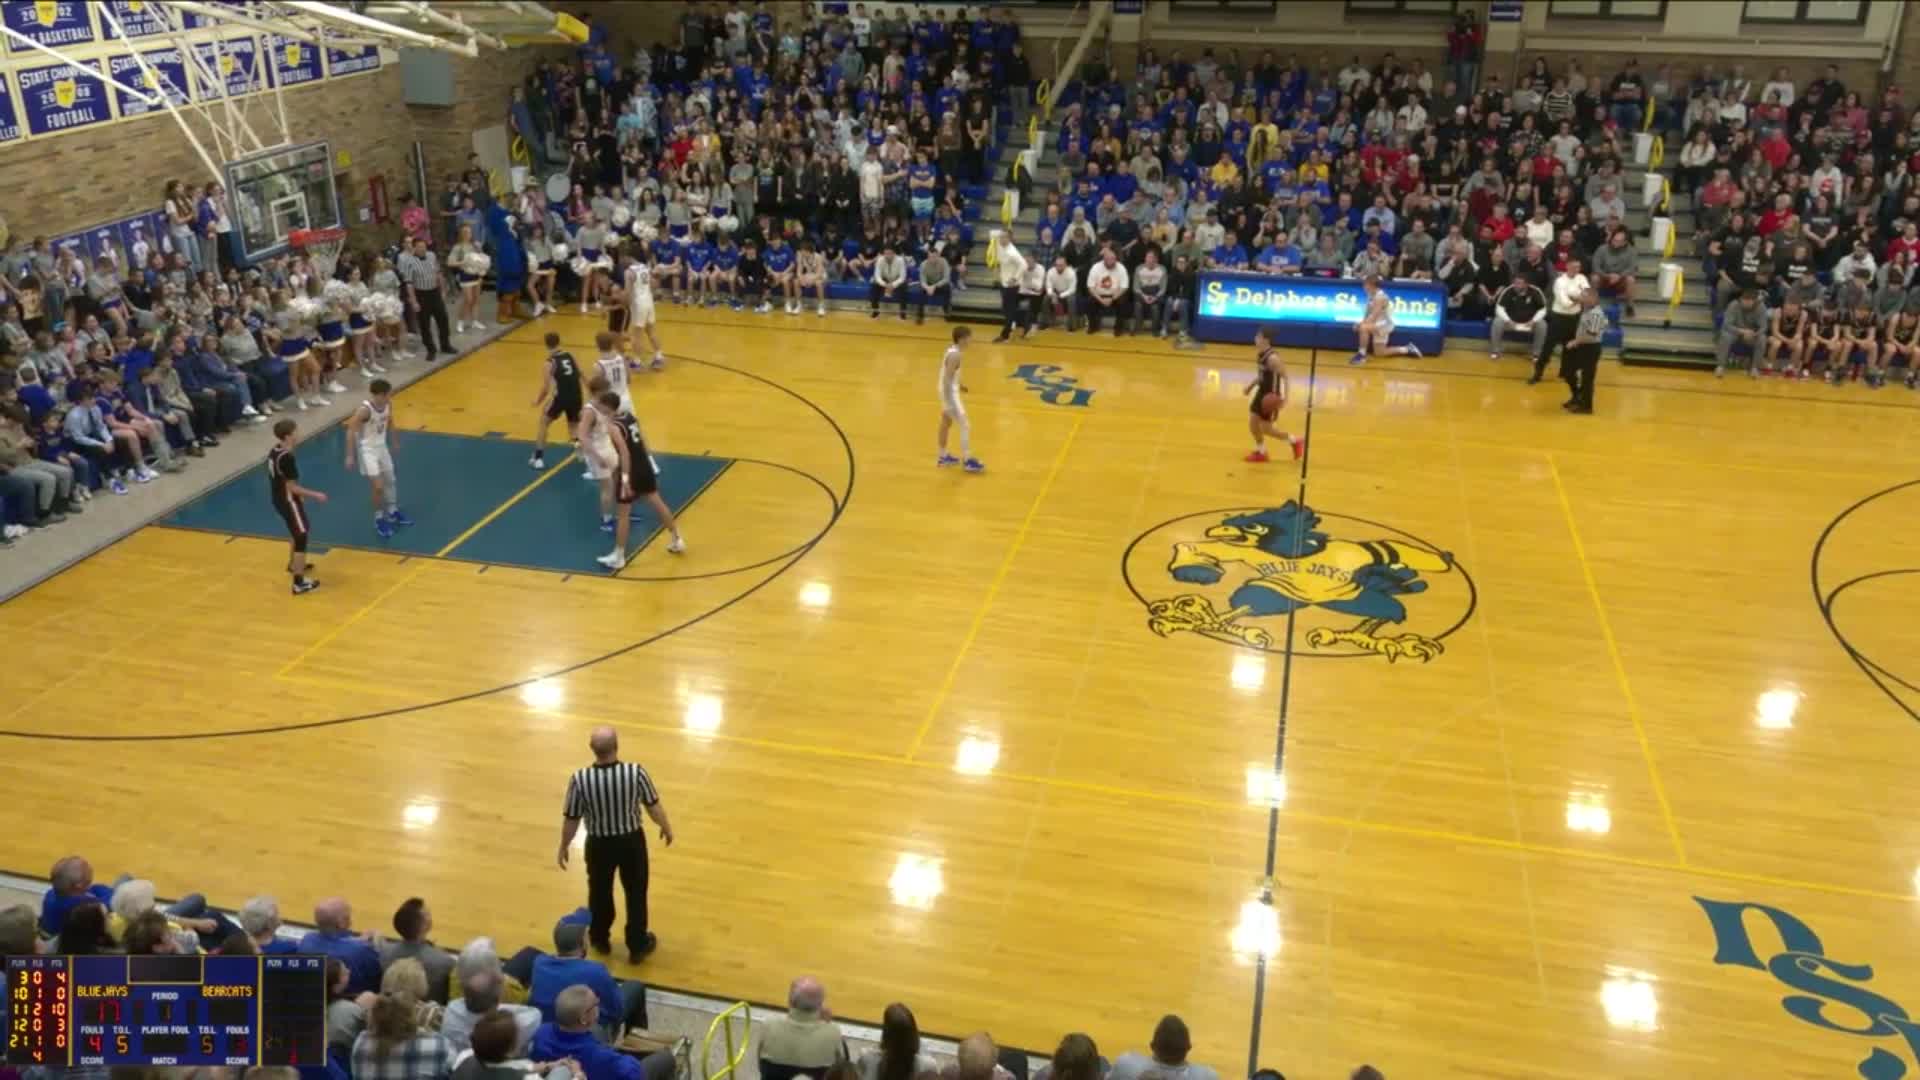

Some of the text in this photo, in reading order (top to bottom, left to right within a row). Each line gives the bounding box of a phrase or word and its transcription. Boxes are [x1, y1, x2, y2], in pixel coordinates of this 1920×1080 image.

[38, 27, 92, 44] BASKETBALL
[20, 69, 49, 89] STATE
[47, 107, 96, 129] FOOTBALL
[1235, 287, 1329, 312] Delphos
[1386, 297, 1437, 316] ohn's
[561, 358, 574, 376] 5
[1258, 558, 1351, 583] BLUE JAYS
